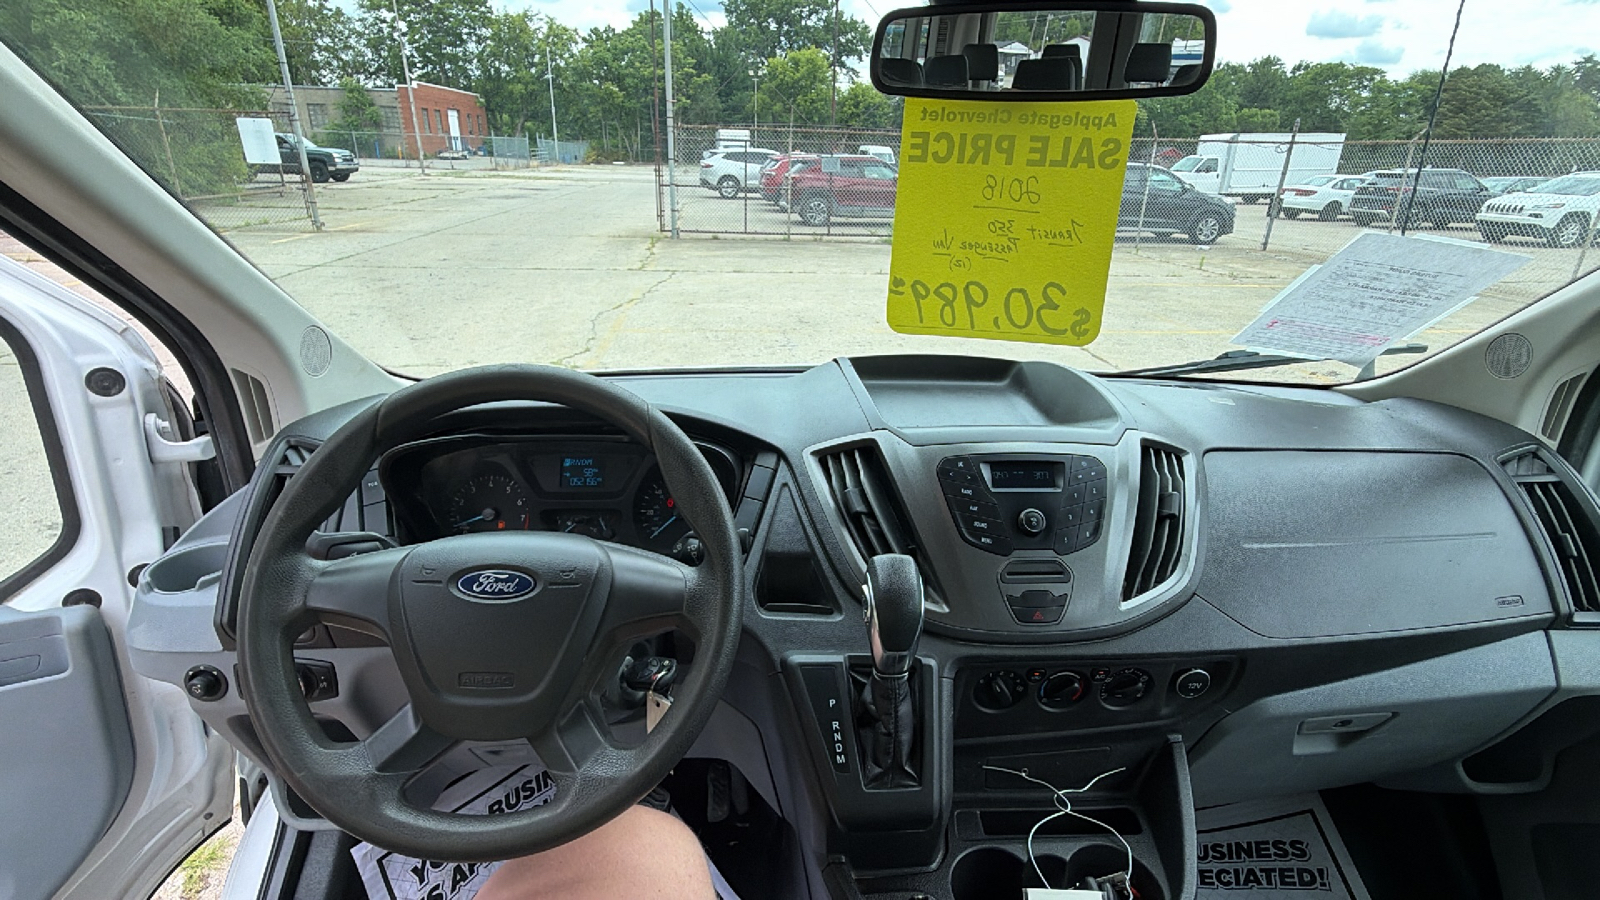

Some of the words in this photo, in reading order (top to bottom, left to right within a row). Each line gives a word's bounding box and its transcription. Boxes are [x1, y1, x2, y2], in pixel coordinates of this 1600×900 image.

[473, 573, 520, 593] Ford
[829, 699, 836, 708] P
[832, 721, 841, 731] R
[834, 732, 842, 741] N
[835, 743, 842, 753] D
[836, 754, 846, 764] M
[1197, 839, 1311, 862] USINESS
